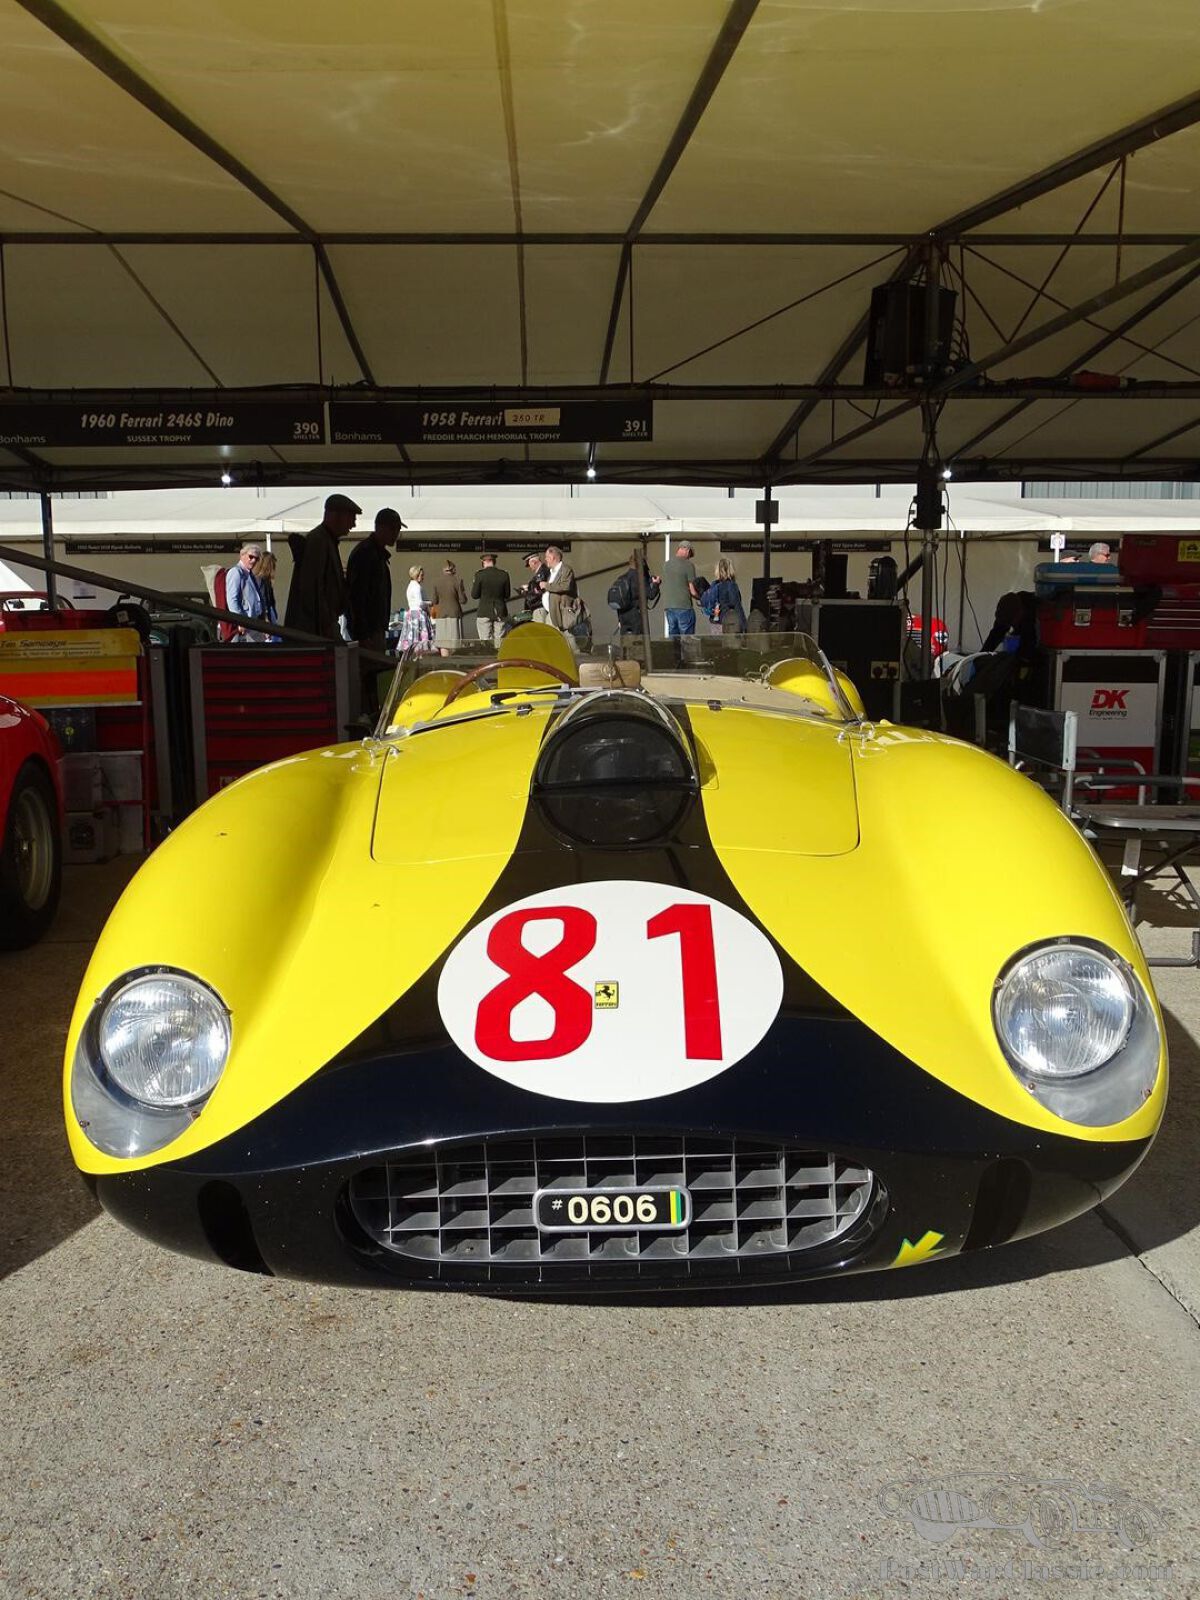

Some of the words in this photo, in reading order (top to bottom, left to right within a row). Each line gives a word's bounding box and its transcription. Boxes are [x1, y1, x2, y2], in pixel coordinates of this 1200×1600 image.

[80, 413, 116, 429] 1960
[119, 412, 163, 428] Ferrari
[166, 411, 203, 428] 246S
[205, 412, 235, 427] Dino
[422, 411, 457, 427] 1958
[460, 410, 504, 426] Ferrari
[624, 419, 648, 432] 391
[293, 421, 320, 435] 390
[126, 434, 158, 443] SUSSEX
[159, 434, 192, 443] TROPHY
[334, 431, 382, 442] Bonhams
[422, 433, 455, 441] FREDDIE
[456, 432, 486, 441] MARCH
[486, 432, 528, 441] MEMORIAL
[529, 432, 561, 441] TROPHY
[1090, 688, 1131, 709] DK
[1088, 709, 1128, 717] Engineering
[474, 903, 723, 1062] 81
[567, 1194, 658, 1225] 0606
